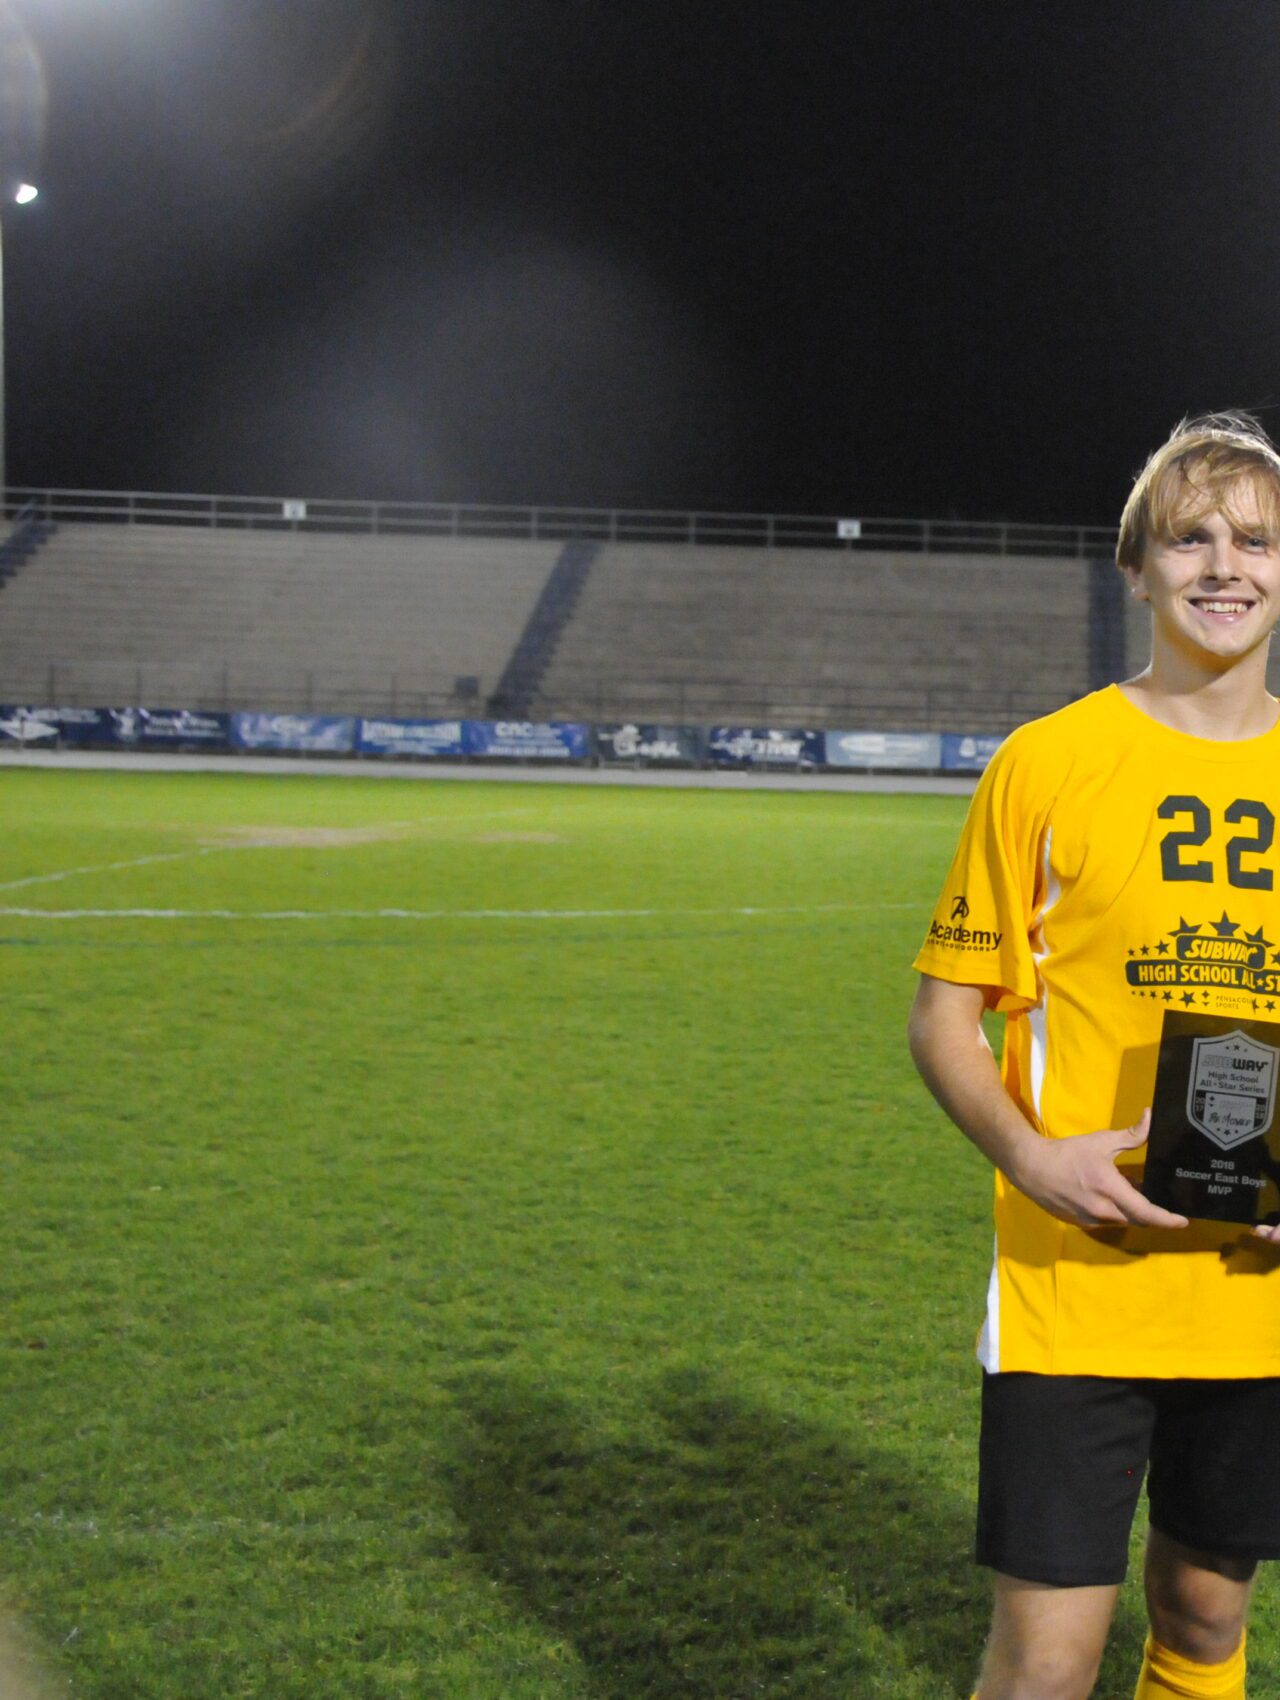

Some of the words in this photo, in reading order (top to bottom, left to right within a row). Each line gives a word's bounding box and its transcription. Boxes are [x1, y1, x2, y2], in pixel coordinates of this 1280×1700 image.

[1157, 795, 1275, 891] 22
[929, 920, 1003, 951] Academy
[1138, 964, 1176, 982] HIGH
[1180, 965, 1239, 985] SCHOOL
[1216, 996, 1252, 1004] PENSACOL
[1216, 1002, 1239, 1010] SPORTS
[1208, 1071, 1228, 1081] High
[1230, 1073, 1259, 1085] School
[1200, 1079, 1213, 1088] All
[1218, 1081, 1237, 1091] Star
[1238, 1083, 1265, 1095] Series
[1210, 1159, 1235, 1170] 2018
[1175, 1167, 1212, 1180] Soccer
[1215, 1172, 1239, 1184] East
[1241, 1175, 1267, 1188] Boys
[1208, 1184, 1233, 1195] MVP
